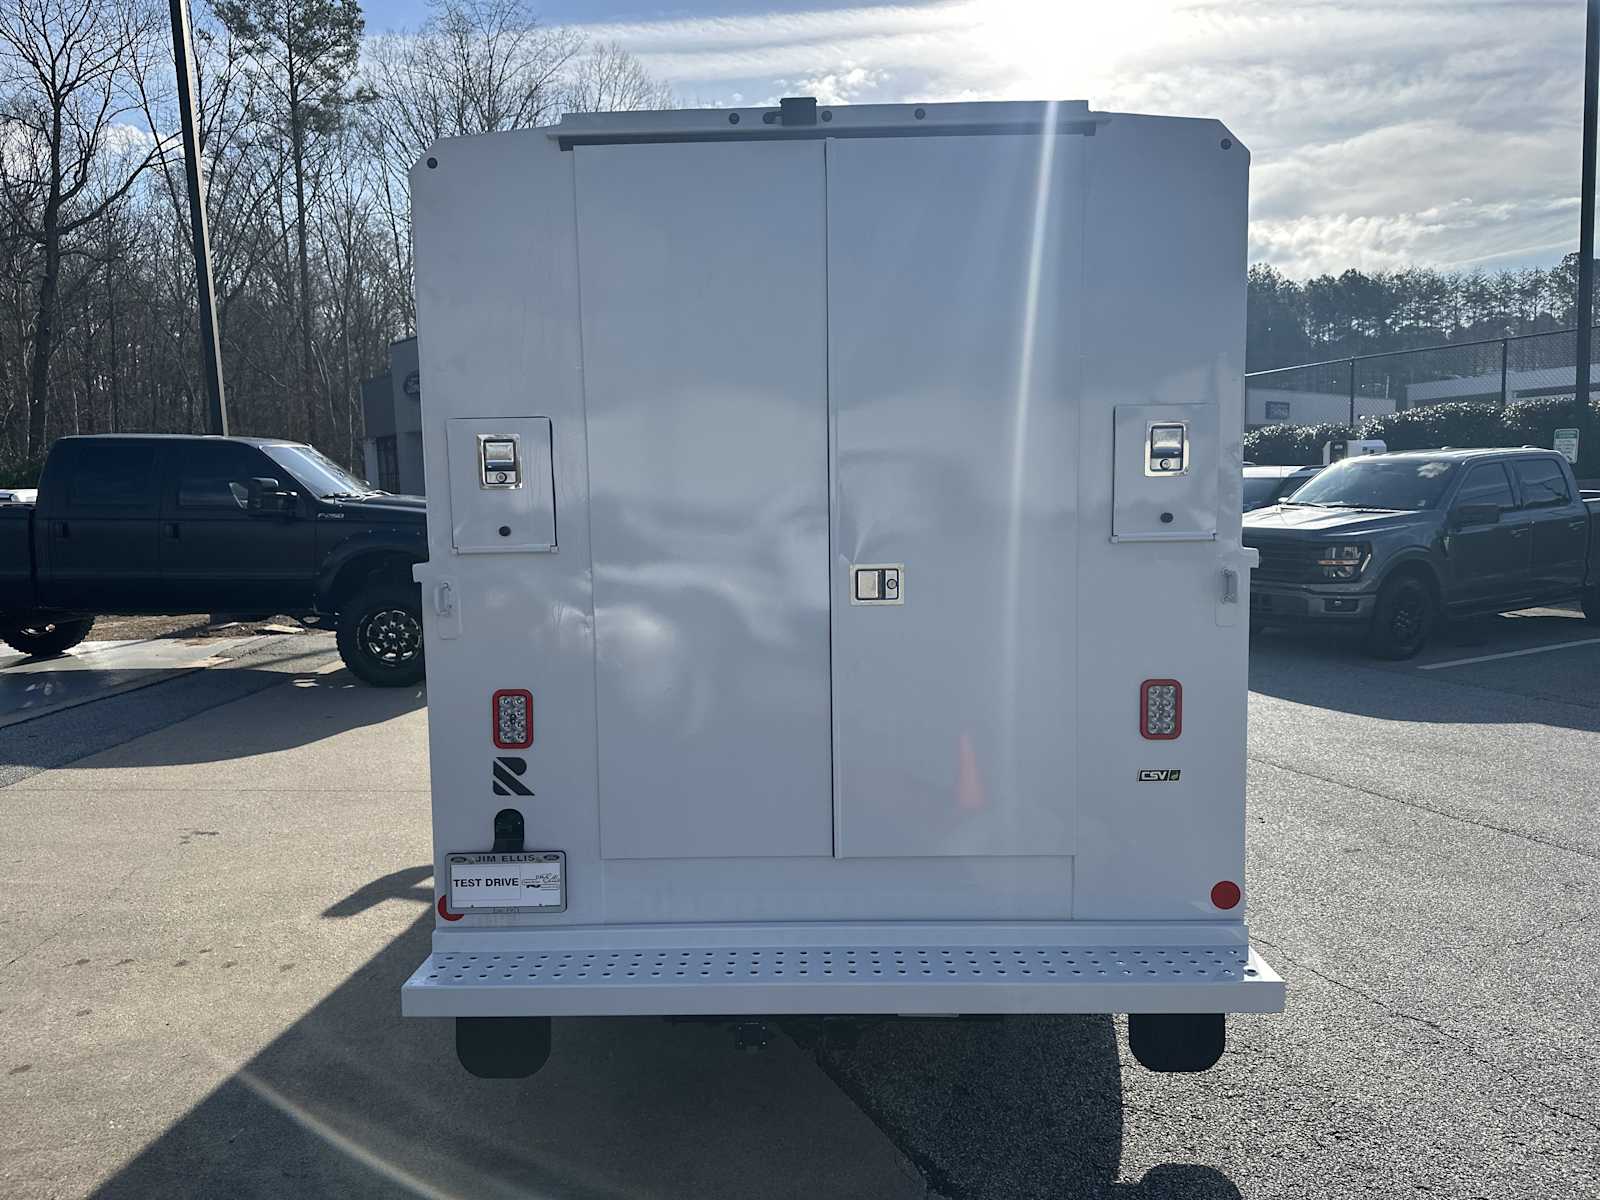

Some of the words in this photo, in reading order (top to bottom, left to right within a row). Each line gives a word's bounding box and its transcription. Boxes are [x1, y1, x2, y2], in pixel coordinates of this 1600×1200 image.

[1141, 771, 1167, 780] CSV
[474, 855, 496, 863] JIM
[501, 854, 536, 863] ELLIS
[453, 879, 482, 888] TEST
[485, 877, 520, 887] DRIVE
